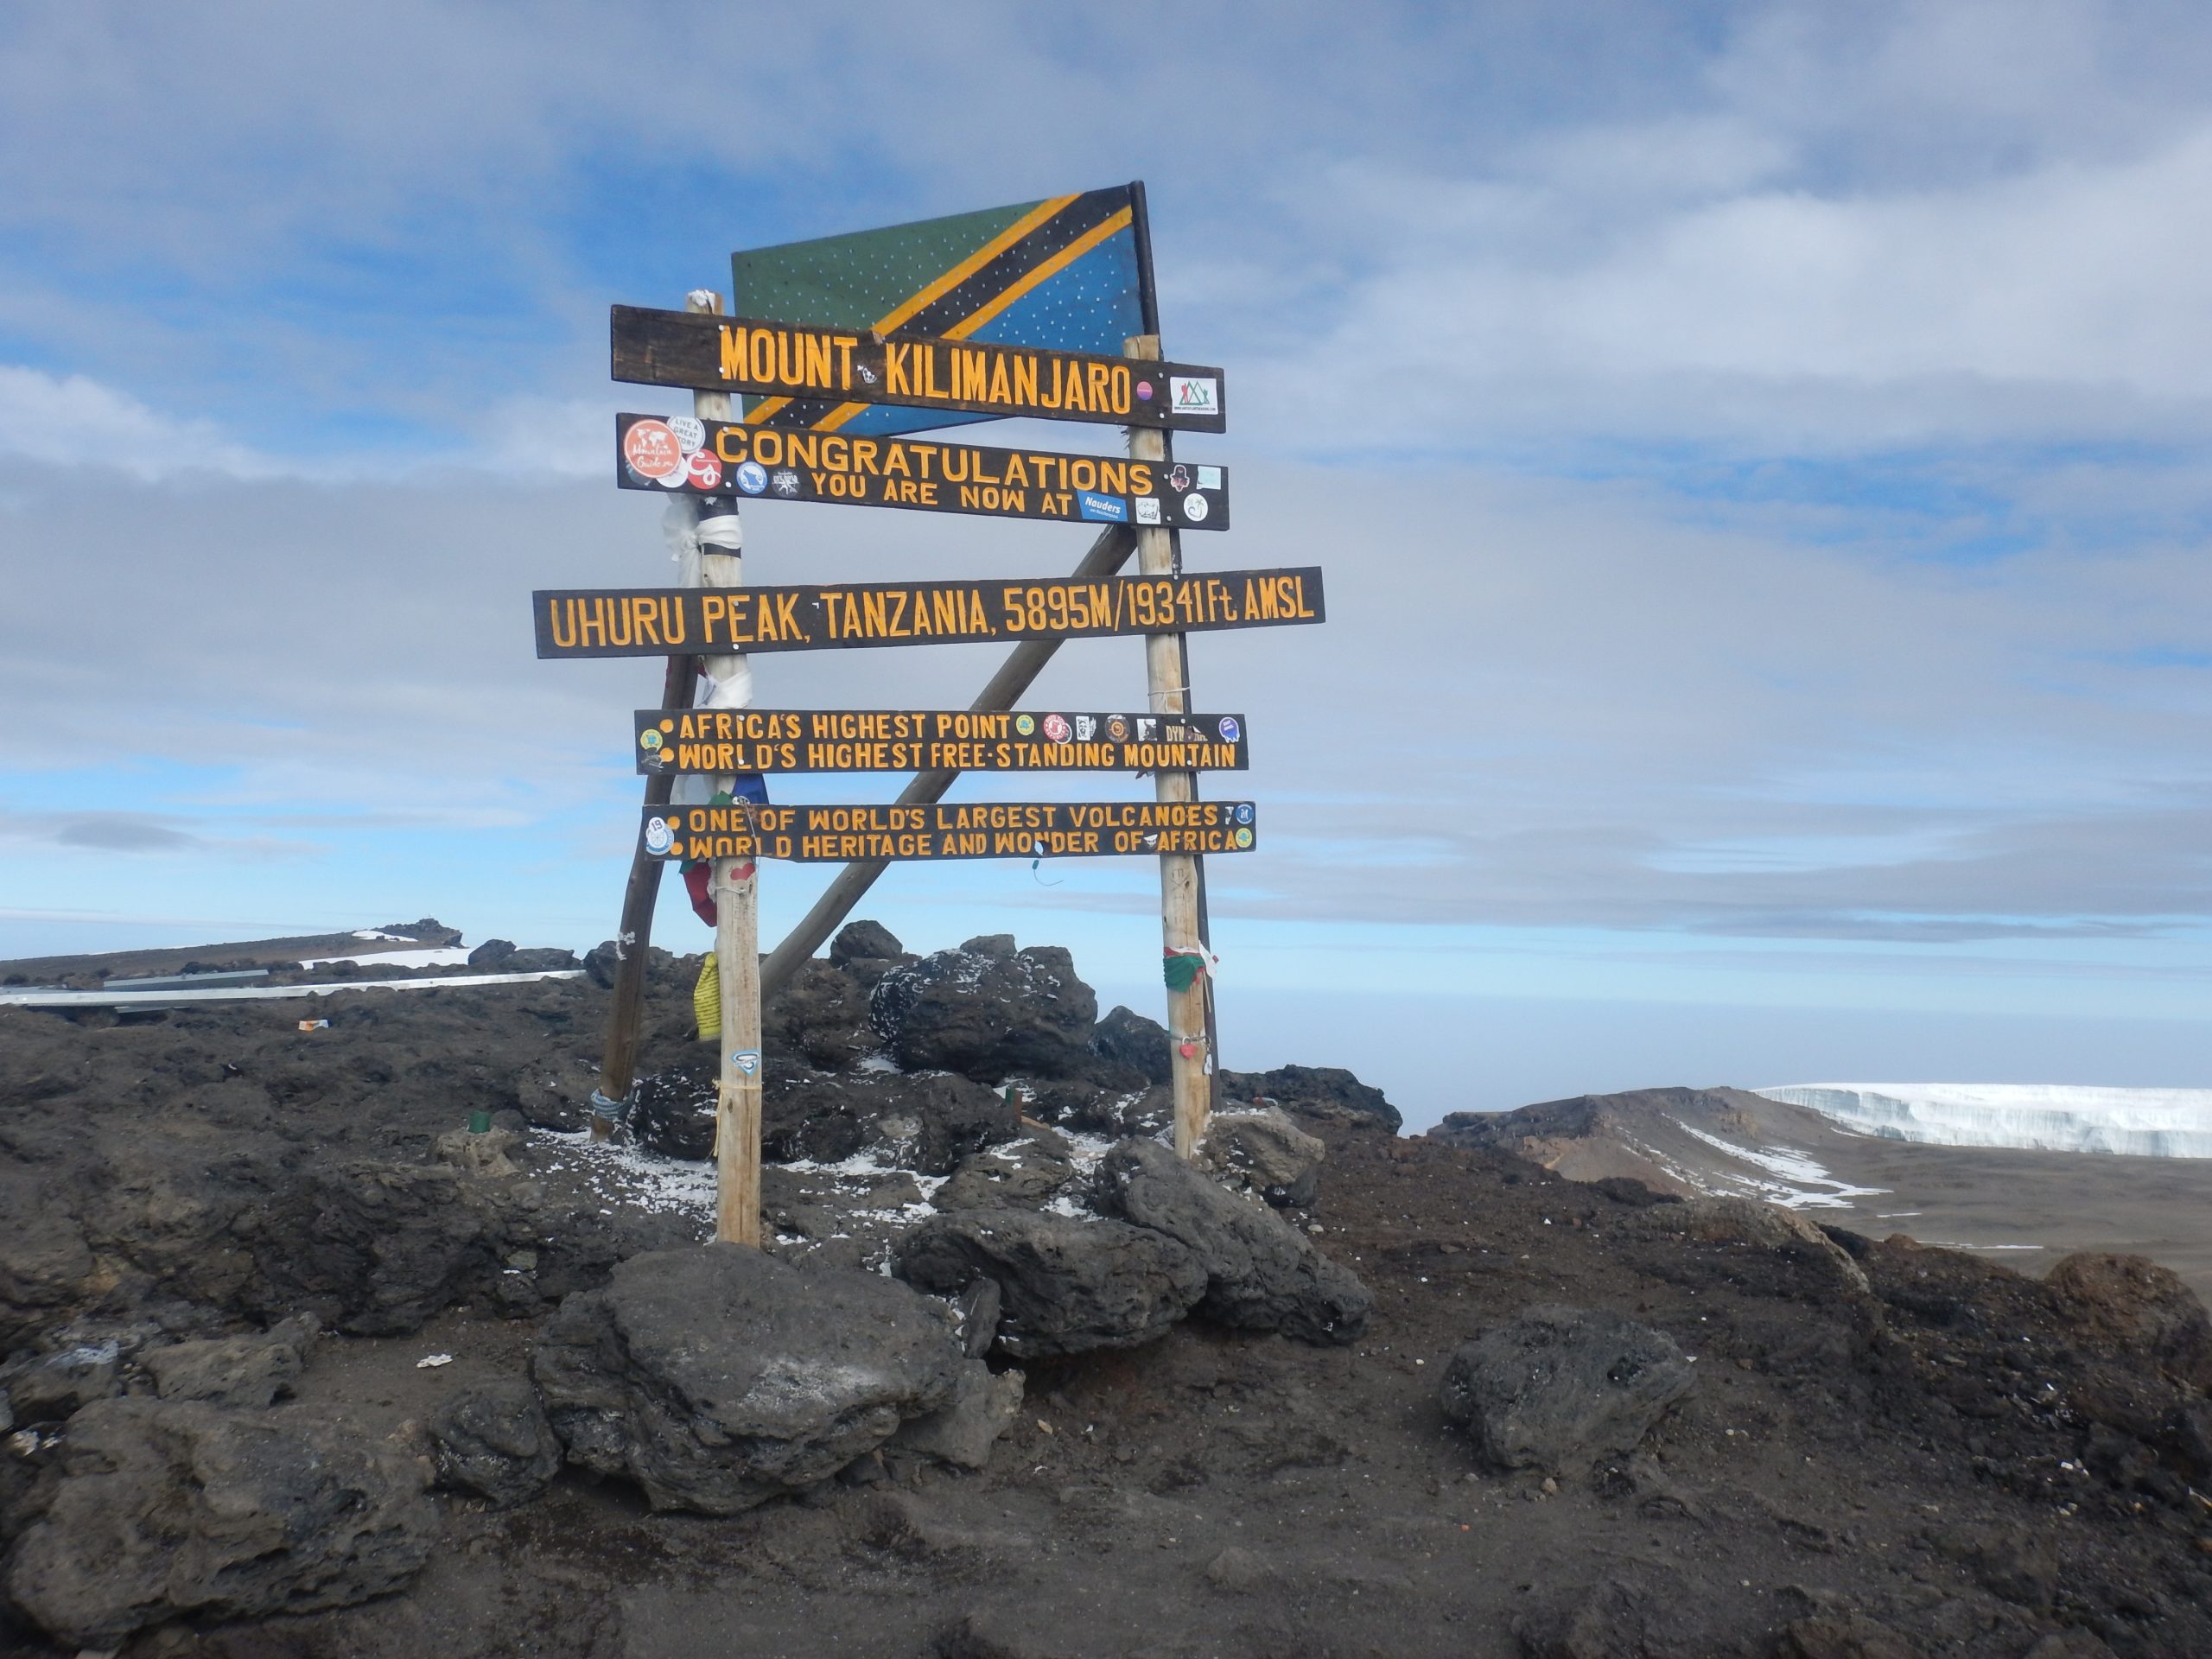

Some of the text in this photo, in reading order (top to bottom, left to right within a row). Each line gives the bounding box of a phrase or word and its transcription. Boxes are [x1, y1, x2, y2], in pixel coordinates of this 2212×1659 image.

[720, 324, 1131, 415] MOUNT KILIMANJARO
[673, 426, 698, 440] GREAT
[675, 417, 693, 429] LIVE
[715, 427, 1154, 496] CONGRATULATIONS
[811, 472, 867, 499] YOU
[883, 478, 938, 505] ARE
[960, 485, 1026, 512] NOW
[1041, 492, 1073, 516] AT
[1085, 496, 1122, 515] Nauders
[550, 595, 686, 648] UHURU
[1244, 575, 1315, 620] AMSL
[679, 713, 1010, 740] AFRICA'S HIGHEST POINT
[679, 742, 797, 770] WORLD'S
[808, 742, 924, 769] HIGHEST
[1123, 743, 1236, 768] MOUNTAIN
[652, 819, 663, 831] 19
[689, 804, 1217, 832] ONE OF WORLD'S LARGEST VOLCANOES
[802, 833, 931, 858] HERITAGE
[942, 833, 987, 855] AND
[1115, 830, 1144, 852] OF
[1157, 830, 1238, 851] AFRICA
